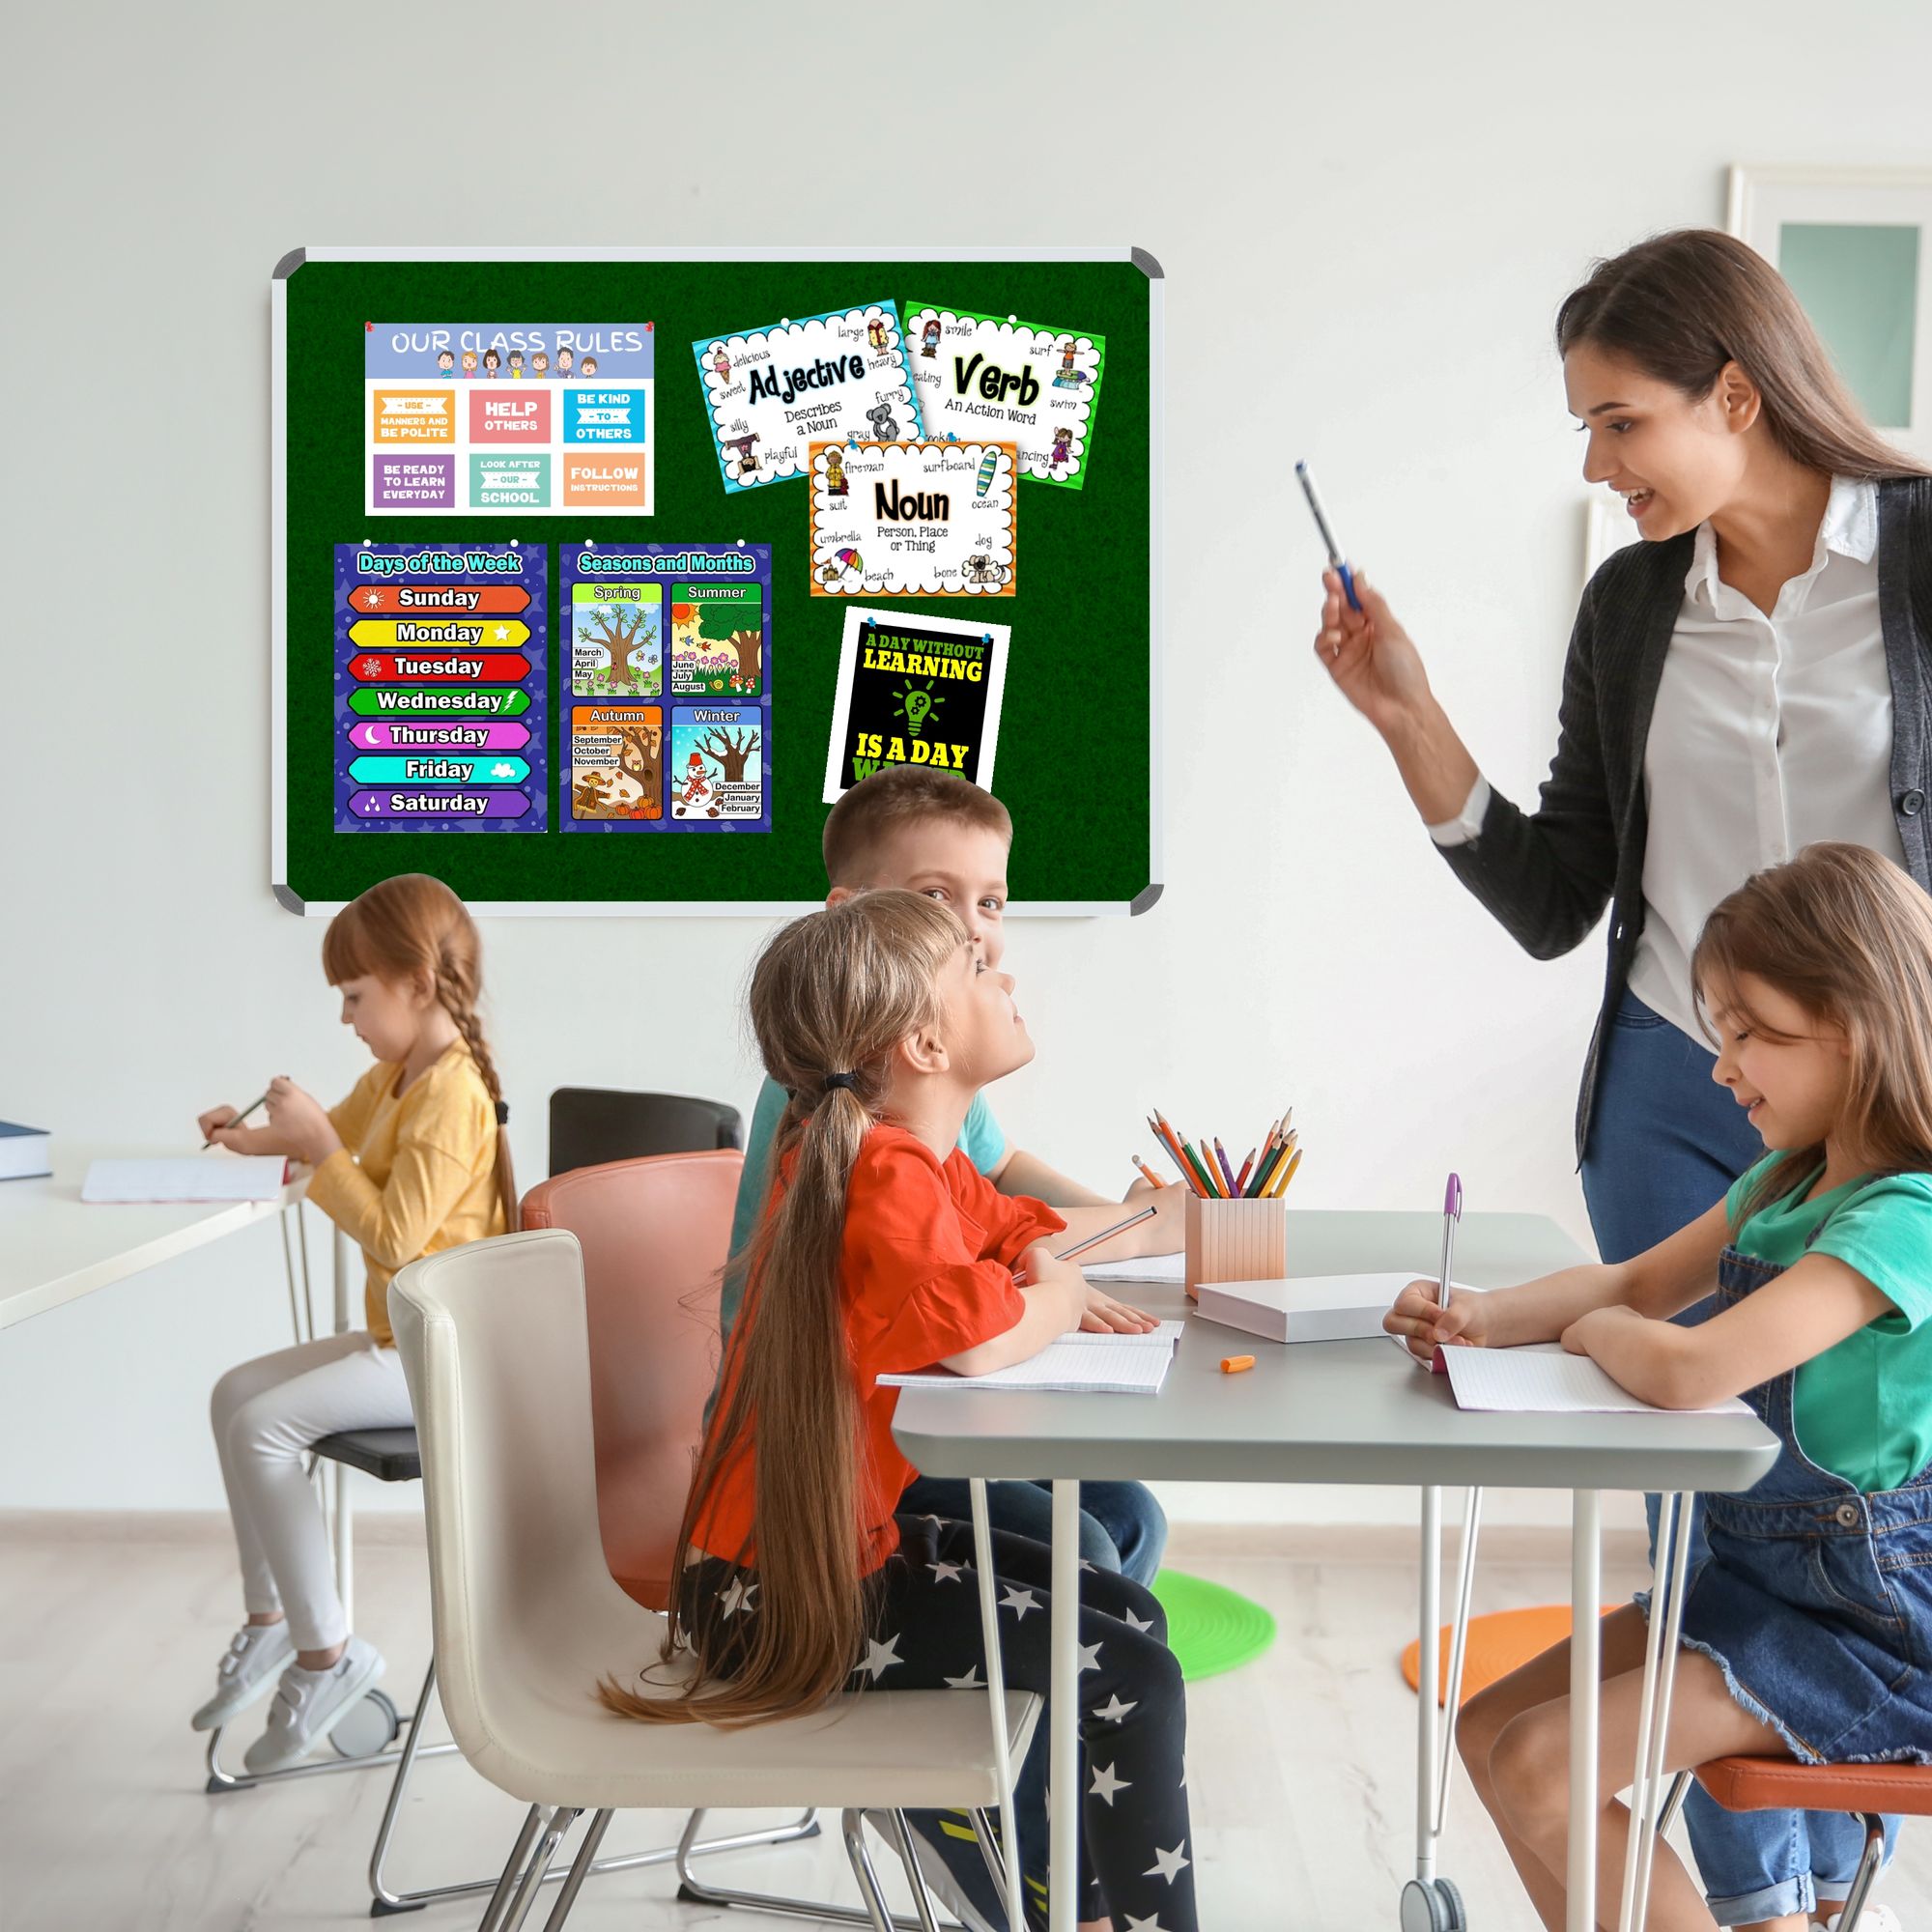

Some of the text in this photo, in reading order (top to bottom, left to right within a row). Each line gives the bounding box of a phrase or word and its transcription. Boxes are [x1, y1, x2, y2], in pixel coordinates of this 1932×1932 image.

[838, 326, 865, 342] large
[945, 324, 973, 337] smile
[391, 330, 642, 353] OUR CLASS RULES
[1029, 345, 1054, 356] surf
[732, 350, 771, 368] delicious
[867, 355, 898, 370] heavy
[749, 355, 866, 405] Adjective
[913, 371, 942, 388] eating
[954, 353, 1039, 406] Verb
[719, 382, 747, 400] sweet
[875, 387, 904, 405] furry
[578, 394, 631, 404] BE KIND
[1049, 398, 1077, 411] swim
[485, 402, 538, 416] HELP
[784, 401, 842, 423] Describes
[945, 398, 1037, 425] An Action Word
[484, 421, 538, 431] OTHERS
[729, 418, 750, 433] silly
[797, 417, 838, 436] a Noun
[381, 428, 448, 438] BE POLITE
[576, 429, 632, 439] OTHERS
[847, 431, 870, 441] gray
[764, 447, 798, 465] playful
[1016, 450, 1049, 469] ancing
[384, 465, 445, 474] BE READY
[844, 461, 885, 474] fireman
[923, 458, 976, 473] surfboard
[571, 468, 639, 479] FOLLOW
[384, 477, 445, 487] TO LEARN
[383, 490, 445, 499] EVERYDAY
[480, 492, 540, 503] SCHOOL
[874, 479, 950, 522] Noun
[829, 497, 848, 511] suit
[971, 497, 999, 510] ocean
[820, 531, 862, 544] umbrella
[920, 526, 949, 538] Place
[890, 540, 936, 554] or Thing
[975, 533, 992, 551] dog
[358, 554, 521, 576] Days of the Week
[580, 554, 753, 572] Seasons and Months
[865, 568, 895, 582] beach
[933, 567, 957, 579] bone
[398, 588, 480, 610] Sunday
[594, 585, 641, 601] Spring
[688, 586, 747, 599] Summer
[396, 623, 483, 645] Monday
[574, 648, 602, 657] March
[866, 633, 984, 660] A DAY WITHOUT
[394, 657, 483, 678] Tuesday
[574, 659, 596, 668] April
[672, 661, 695, 669] June
[863, 648, 983, 682] LEARNING
[574, 670, 593, 679] May
[672, 671, 692, 681] July
[672, 682, 705, 693] August
[377, 691, 503, 713] Wednesday
[590, 709, 645, 723] Autumn
[694, 710, 741, 723] Winter
[389, 725, 489, 747] Thursday
[574, 736, 622, 746] September
[574, 747, 611, 755] October
[856, 732, 883, 758] IS
[886, 737, 906, 761] A
[910, 739, 969, 769] DAY
[574, 757, 619, 766] November
[406, 759, 473, 781] Friday
[715, 782, 761, 791] December
[389, 793, 489, 815] Saturday
[724, 793, 761, 804] January
[721, 804, 761, 814] February
